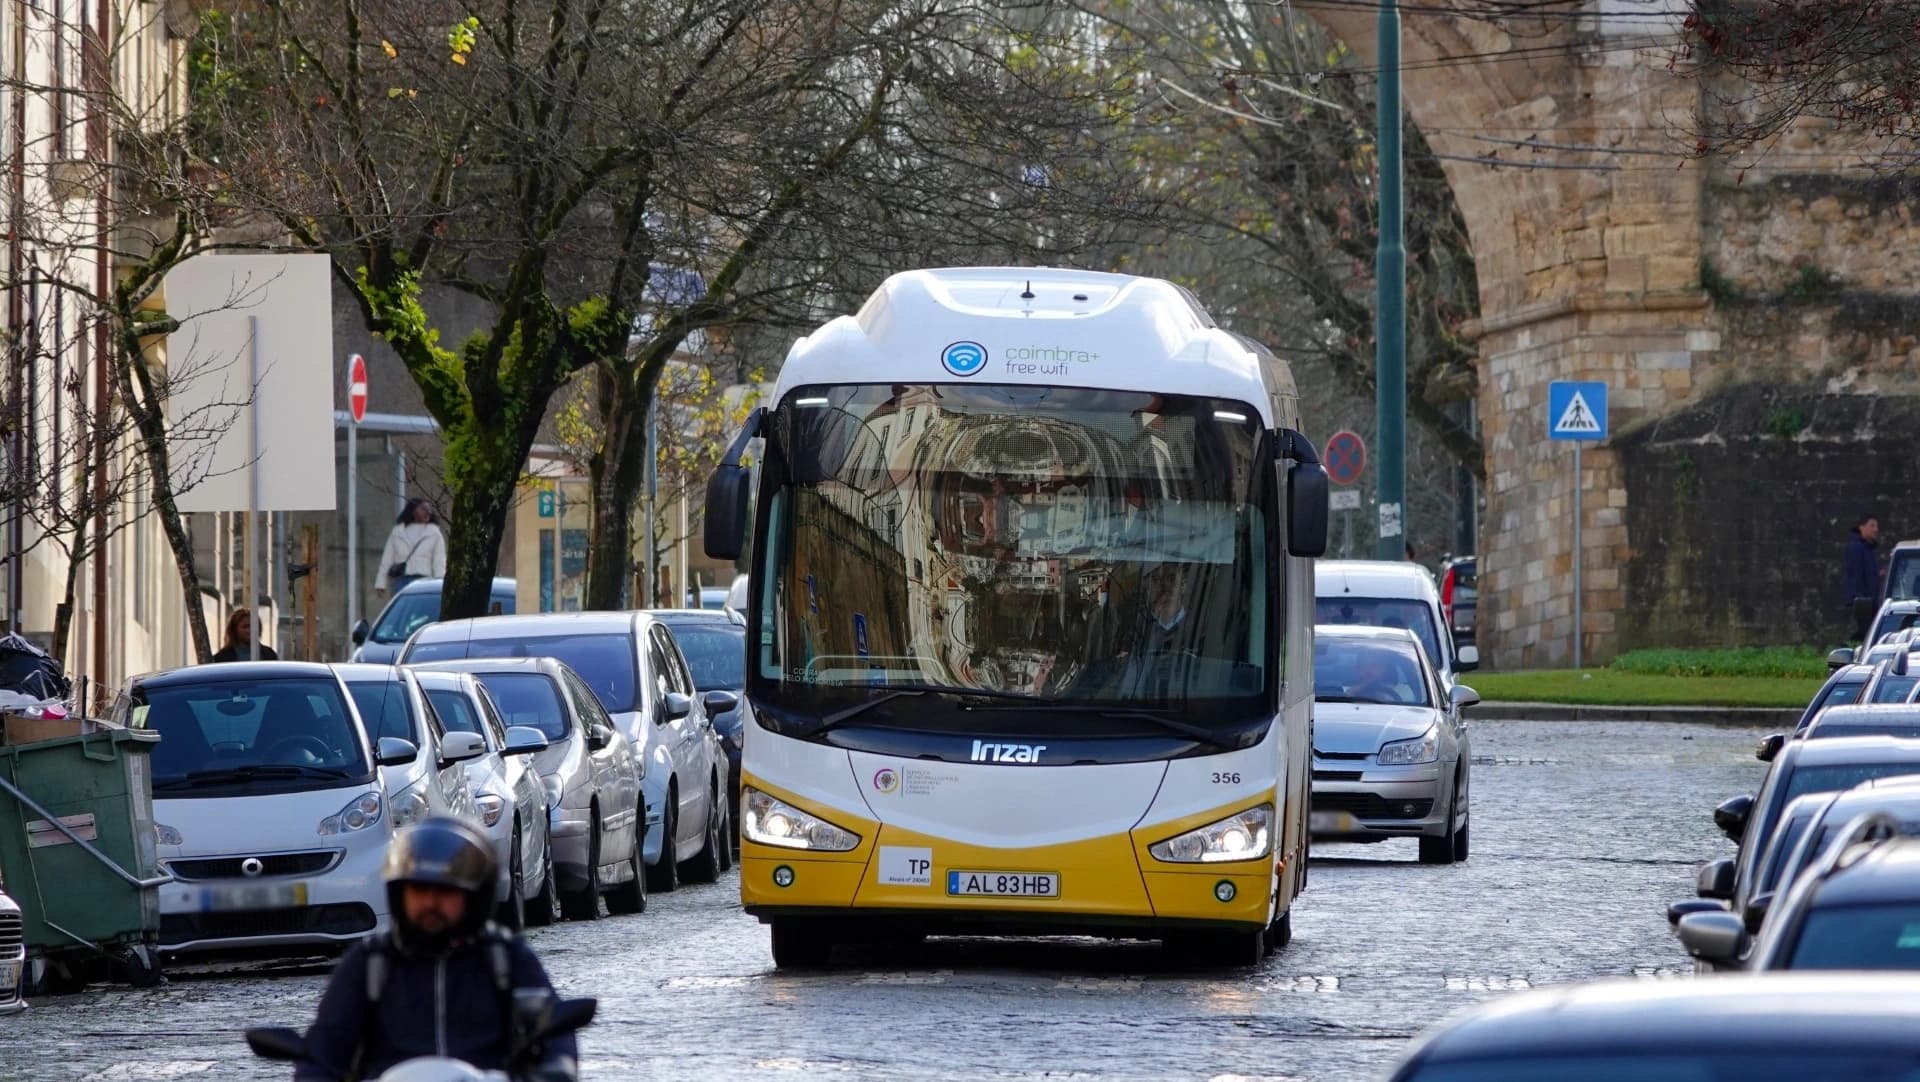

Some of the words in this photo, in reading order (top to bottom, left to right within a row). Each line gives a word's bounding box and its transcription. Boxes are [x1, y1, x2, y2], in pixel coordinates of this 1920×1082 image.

[1005, 345, 1102, 363] coimbra+
[1006, 360, 1037, 374] free
[1040, 362, 1069, 376] wifi
[971, 739, 1047, 763] Irizar
[1211, 772, 1241, 784] 356
[908, 859, 930, 875] TP
